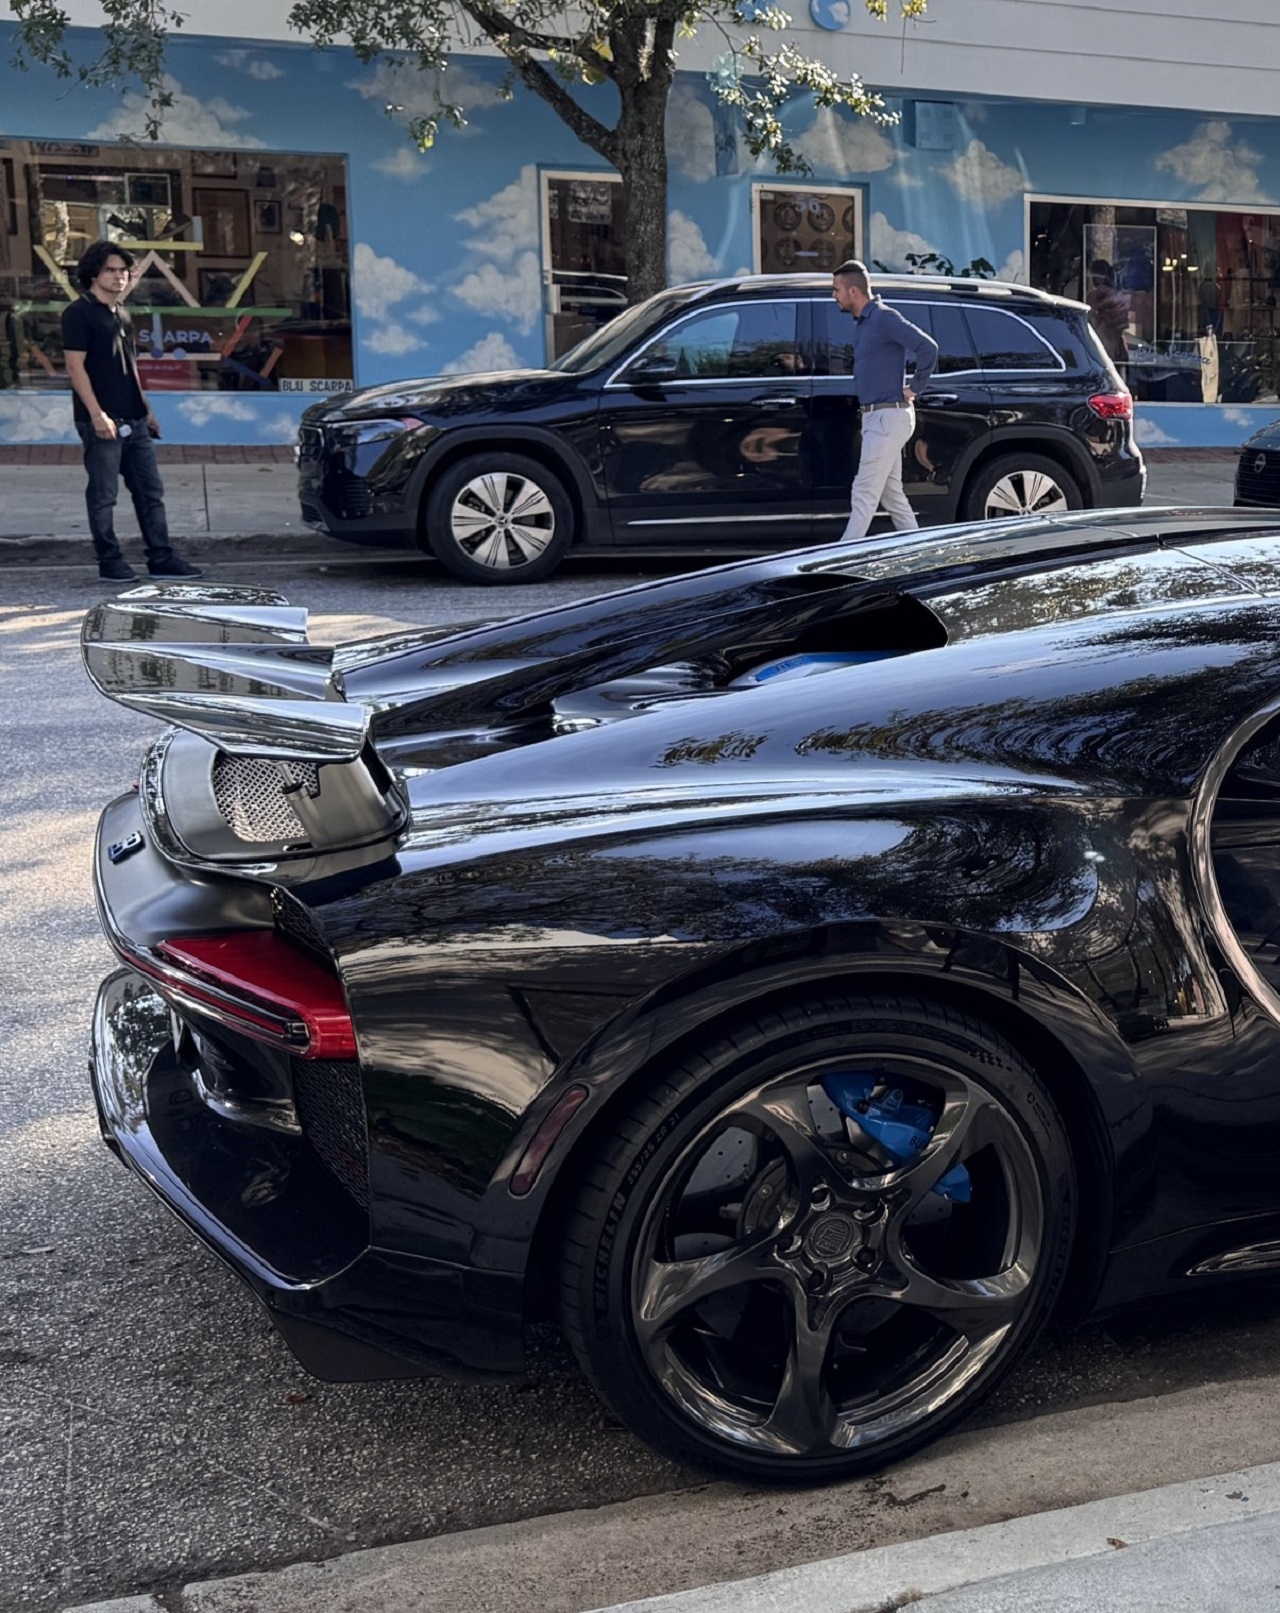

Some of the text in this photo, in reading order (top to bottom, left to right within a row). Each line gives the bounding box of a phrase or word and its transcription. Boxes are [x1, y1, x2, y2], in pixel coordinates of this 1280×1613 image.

[794, 196, 820, 213] 56
[282, 379, 352, 393] BLU SCARPA
[594, 1191, 627, 1316] MICHELIN
